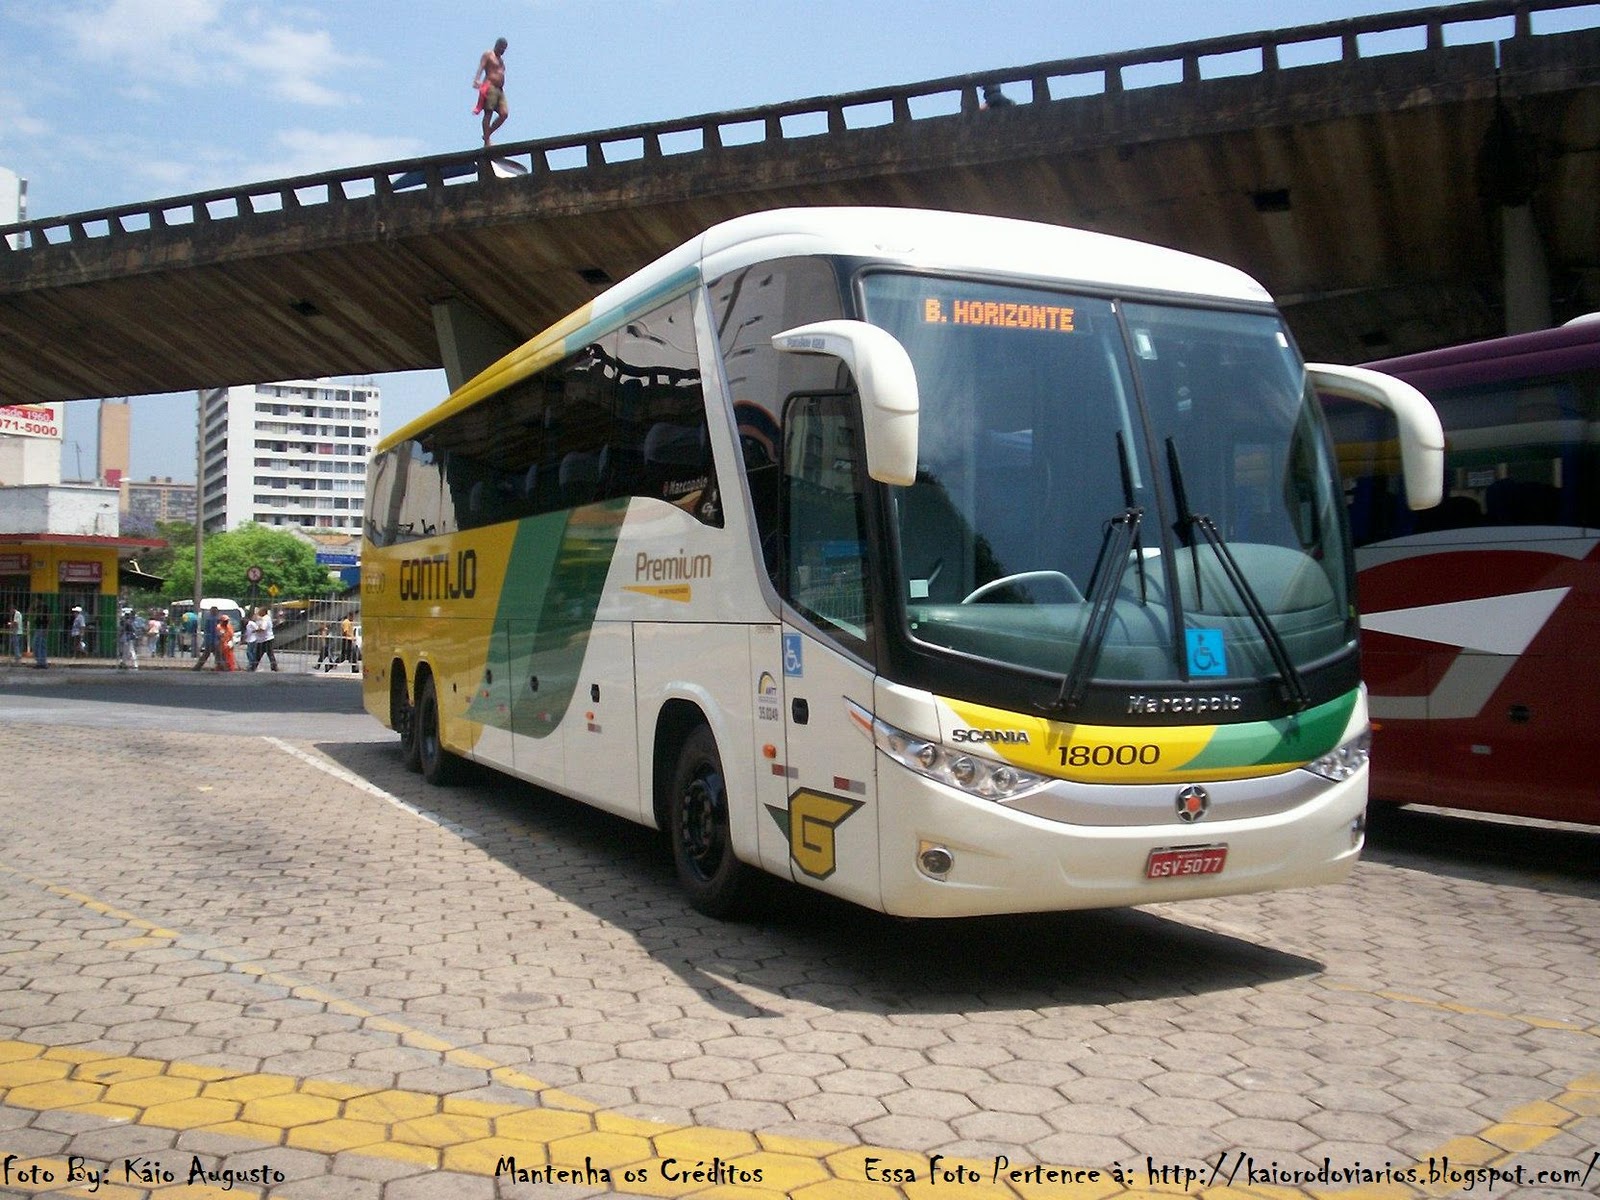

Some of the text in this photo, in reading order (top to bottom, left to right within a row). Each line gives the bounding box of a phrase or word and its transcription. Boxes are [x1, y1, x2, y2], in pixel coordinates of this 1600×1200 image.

[925, 298, 1075, 332] B. HORIZONTE
[400, 549, 477, 601] GONTIJO
[635, 548, 712, 582] Premium
[1127, 695, 1242, 715] Marcopolo
[952, 728, 1031, 745] SCANIA
[1058, 744, 1161, 767] 18000
